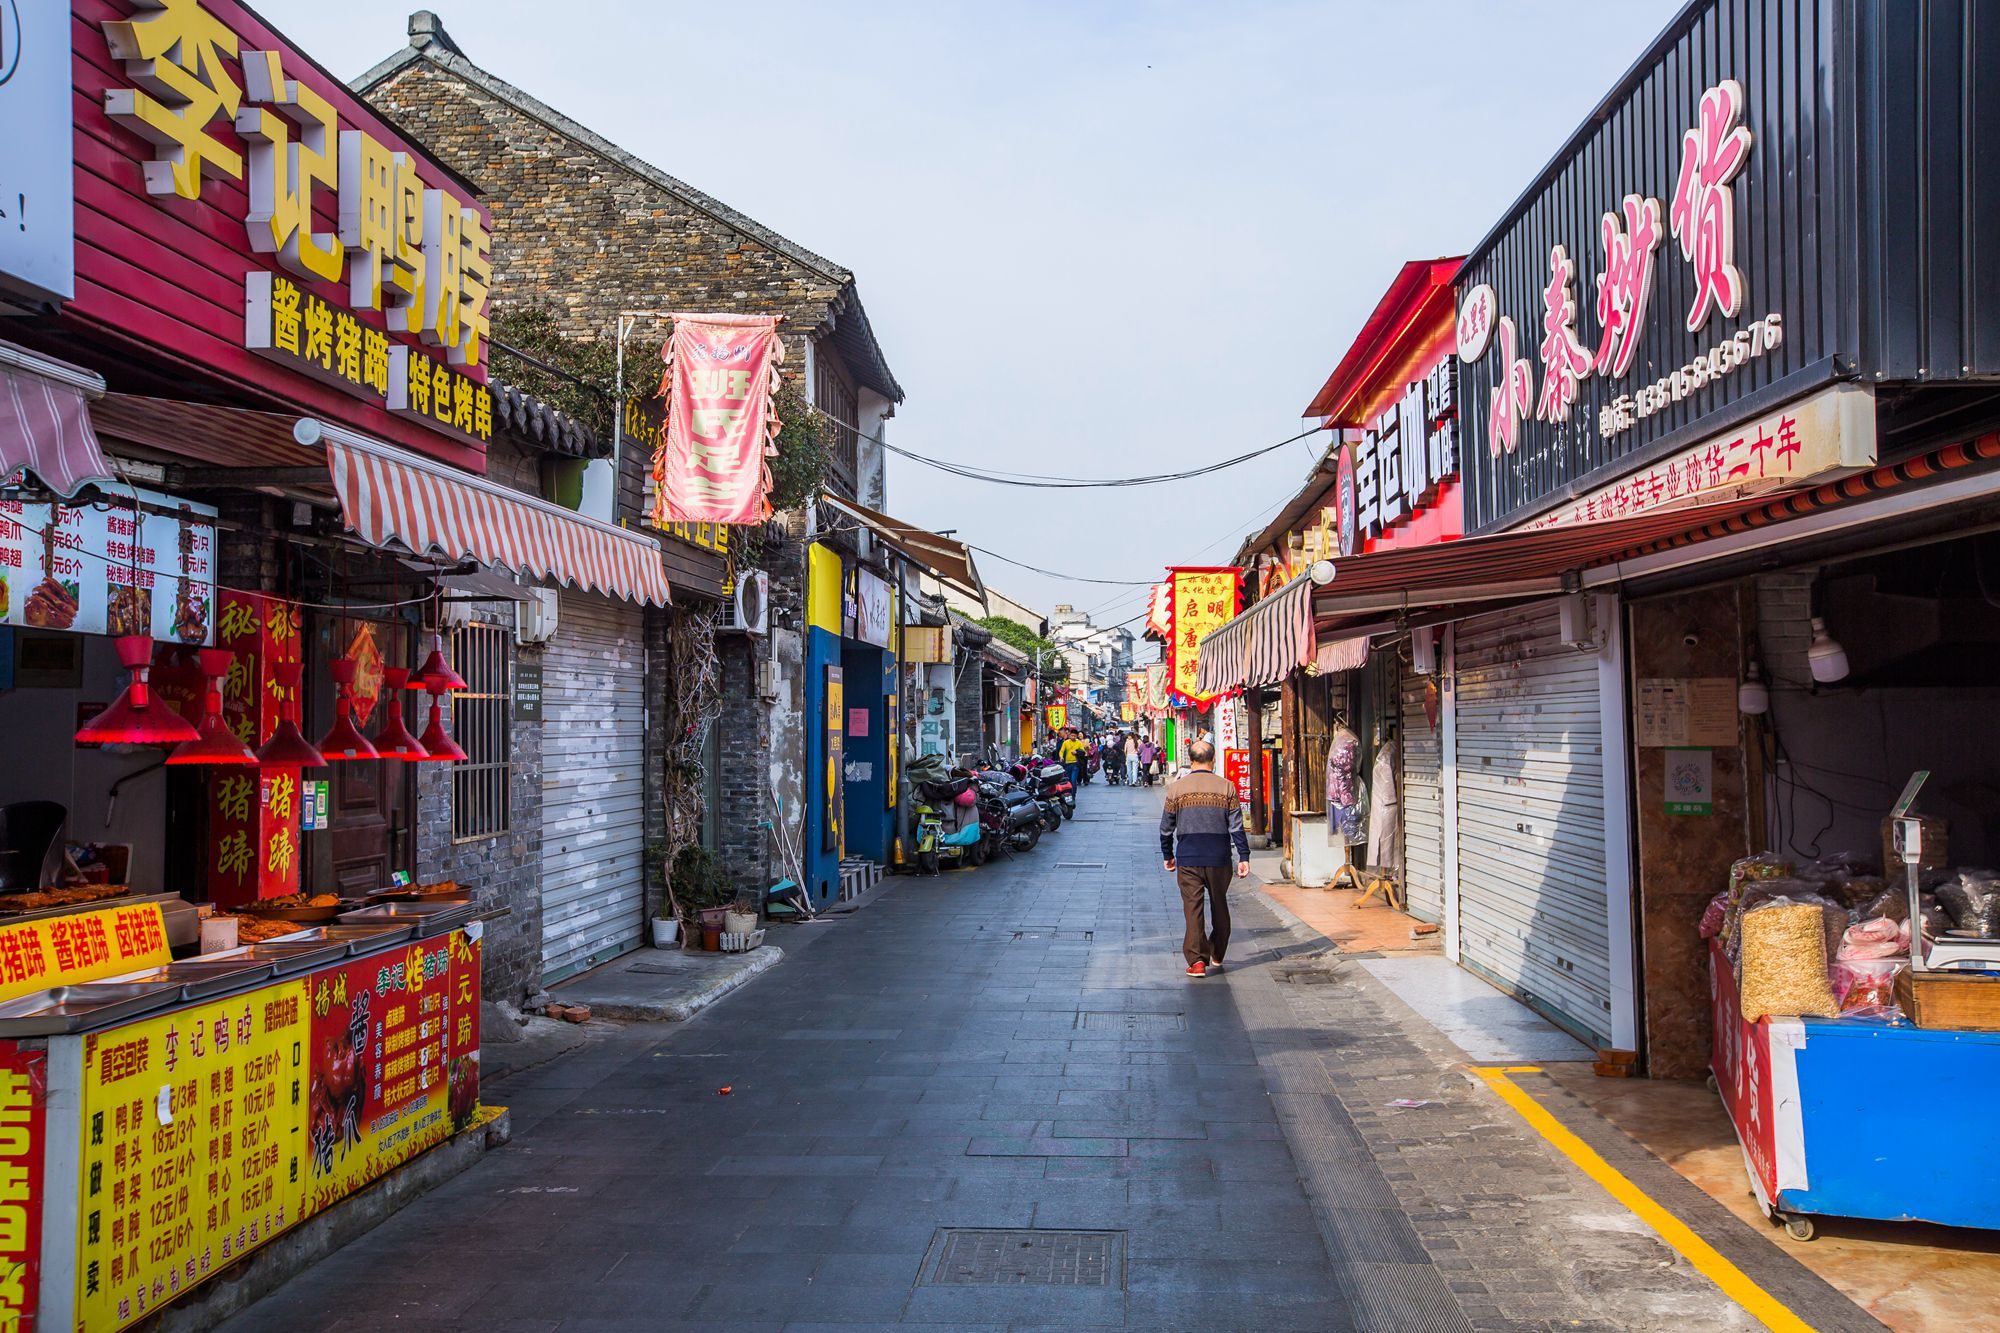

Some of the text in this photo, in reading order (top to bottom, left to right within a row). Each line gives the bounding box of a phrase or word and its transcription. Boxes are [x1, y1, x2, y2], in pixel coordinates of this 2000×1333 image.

[272, 278, 492, 442] 酱烤猪蹄 特色烤串
[1460, 292, 1488, 347] 九里香
[1356, 380, 1426, 540] 幸运咖
[106, 539, 156, 565] 特色烤猪蹄
[106, 564, 155, 589] 秘制烤猪蹄
[1183, 598, 1224, 618] 启明
[0, 906, 163, 986] 猪蹄 酱猪蹄 卤猪蹄
[375, 944, 449, 998] 李记烤猪蹄
[100, 995, 299, 1086] 真空包装 李记鸭脖 提供快递
[114, 1082, 276, 1175] 鸭头 18元/3个 鸭肝 10元/份
[115, 1097, 143, 1138] 鸭脖
[210, 1066, 233, 1100] 鸭翅
[243, 1049, 280, 1084] 12元/6个
[85, 1110, 104, 1299] 现做现卖
[112, 1115, 270, 1213] 鸭架 12元/4个 鸭腿 8元/个
[149, 1185, 189, 1228] 12元/份
[207, 1167, 231, 1200] 鸭心
[241, 1141, 279, 1181] 12元/6串
[110, 1174, 274, 1289] 鸭爪 12元/6个 鸡爪 15元/份
